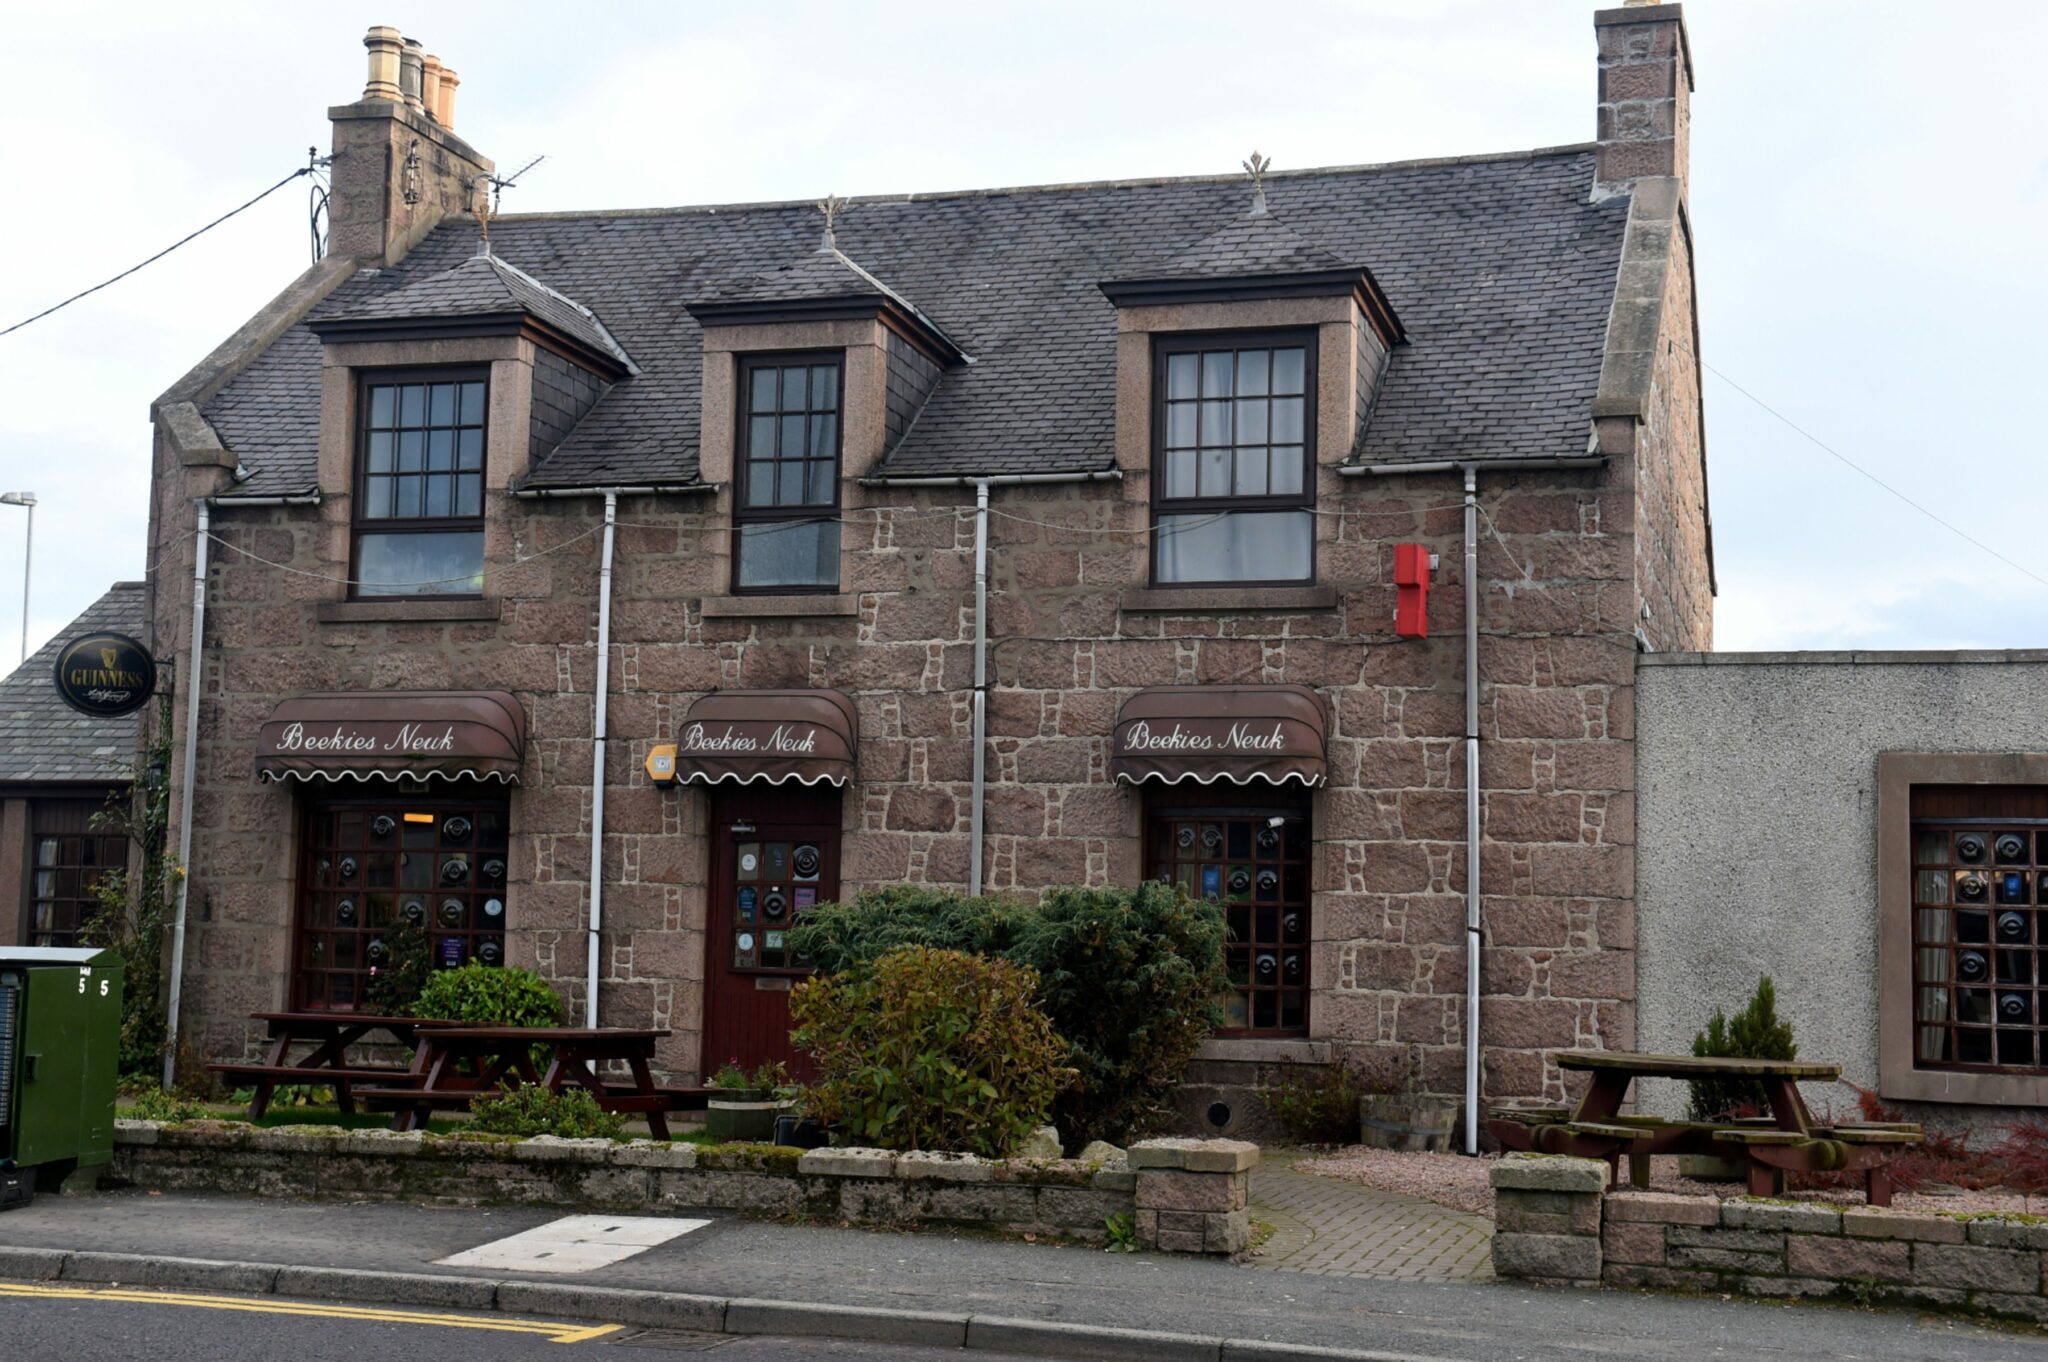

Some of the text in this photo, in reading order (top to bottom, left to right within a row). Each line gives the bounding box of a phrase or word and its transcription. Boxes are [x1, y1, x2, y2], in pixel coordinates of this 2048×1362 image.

[71, 669, 144, 688] GUINNESS
[276, 722, 454, 751] Beekies Neuk
[681, 721, 815, 753] Beekies Neuk
[1124, 720, 1286, 751] Beekies Neuk
[78, 977, 85, 994] 5
[100, 979, 109, 996] 5
